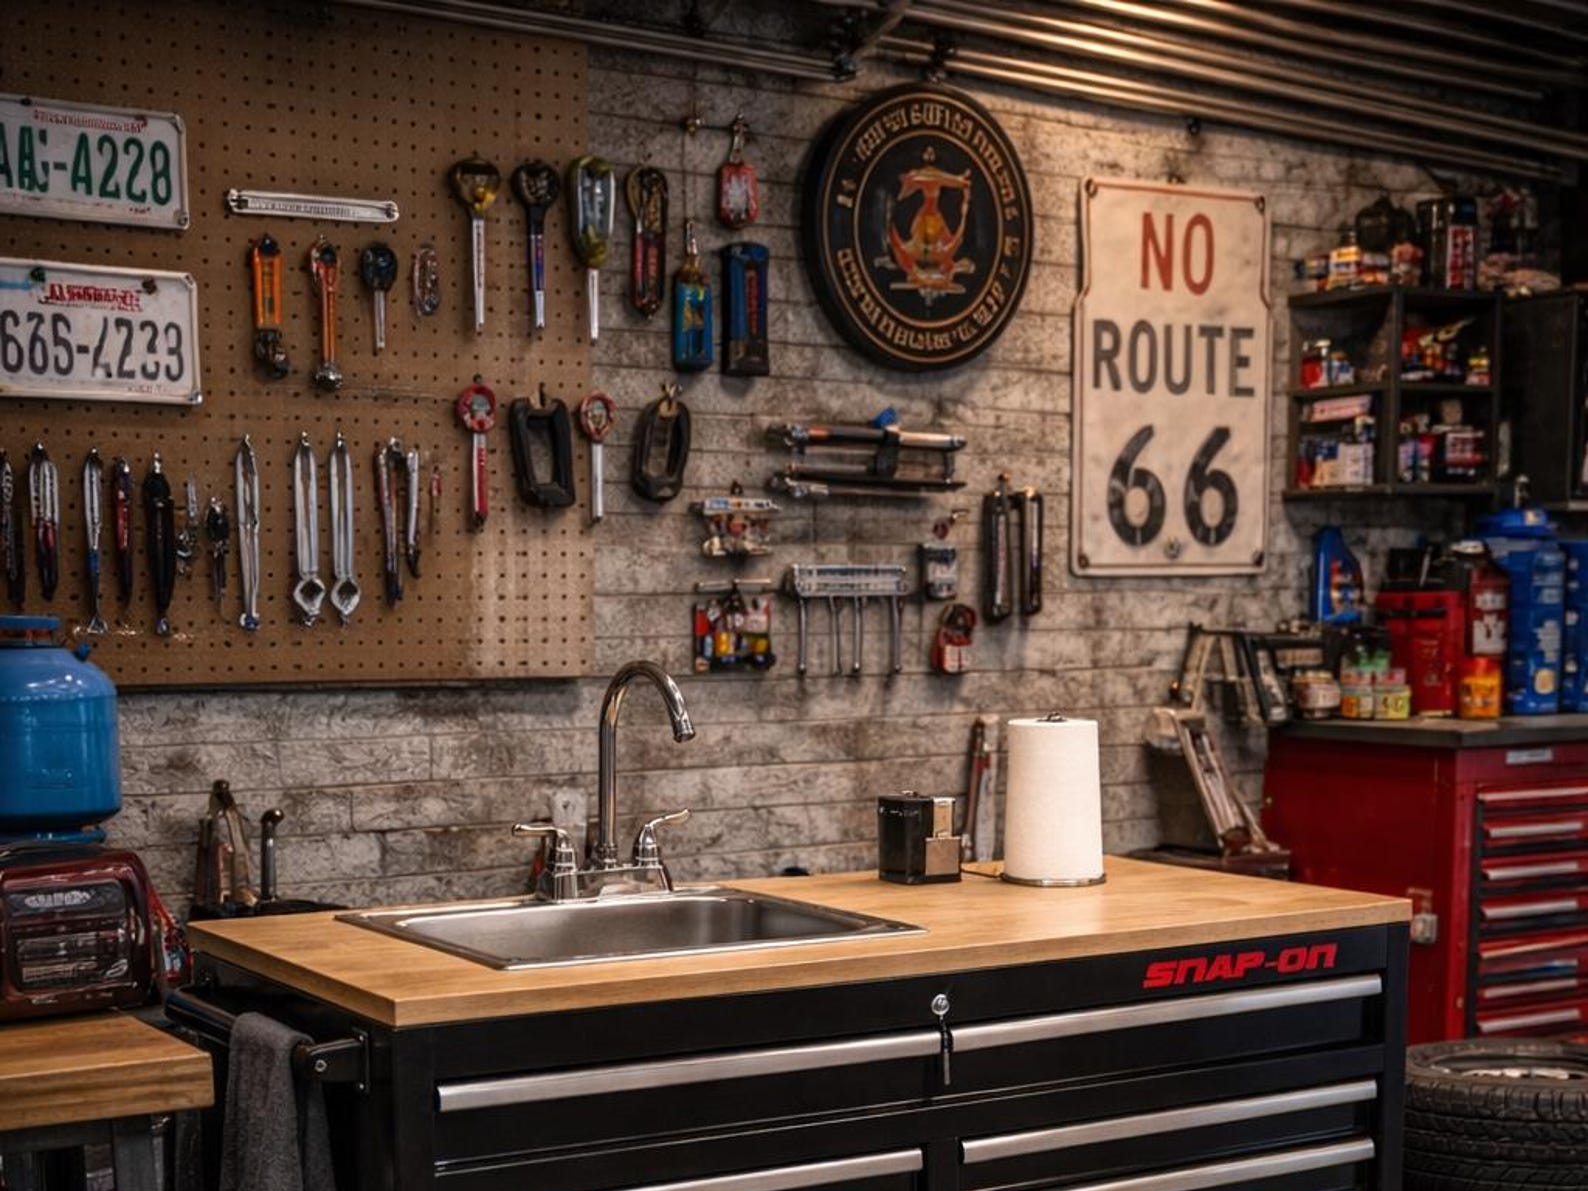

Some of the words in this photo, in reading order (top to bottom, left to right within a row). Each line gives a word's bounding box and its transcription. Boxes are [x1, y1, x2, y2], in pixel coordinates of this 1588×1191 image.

[1139, 211, 1215, 296] NO
[1092, 318, 1255, 398] ROUTE
[1106, 424, 1239, 547] 66
[1142, 942, 1339, 989] SNAP-ON
